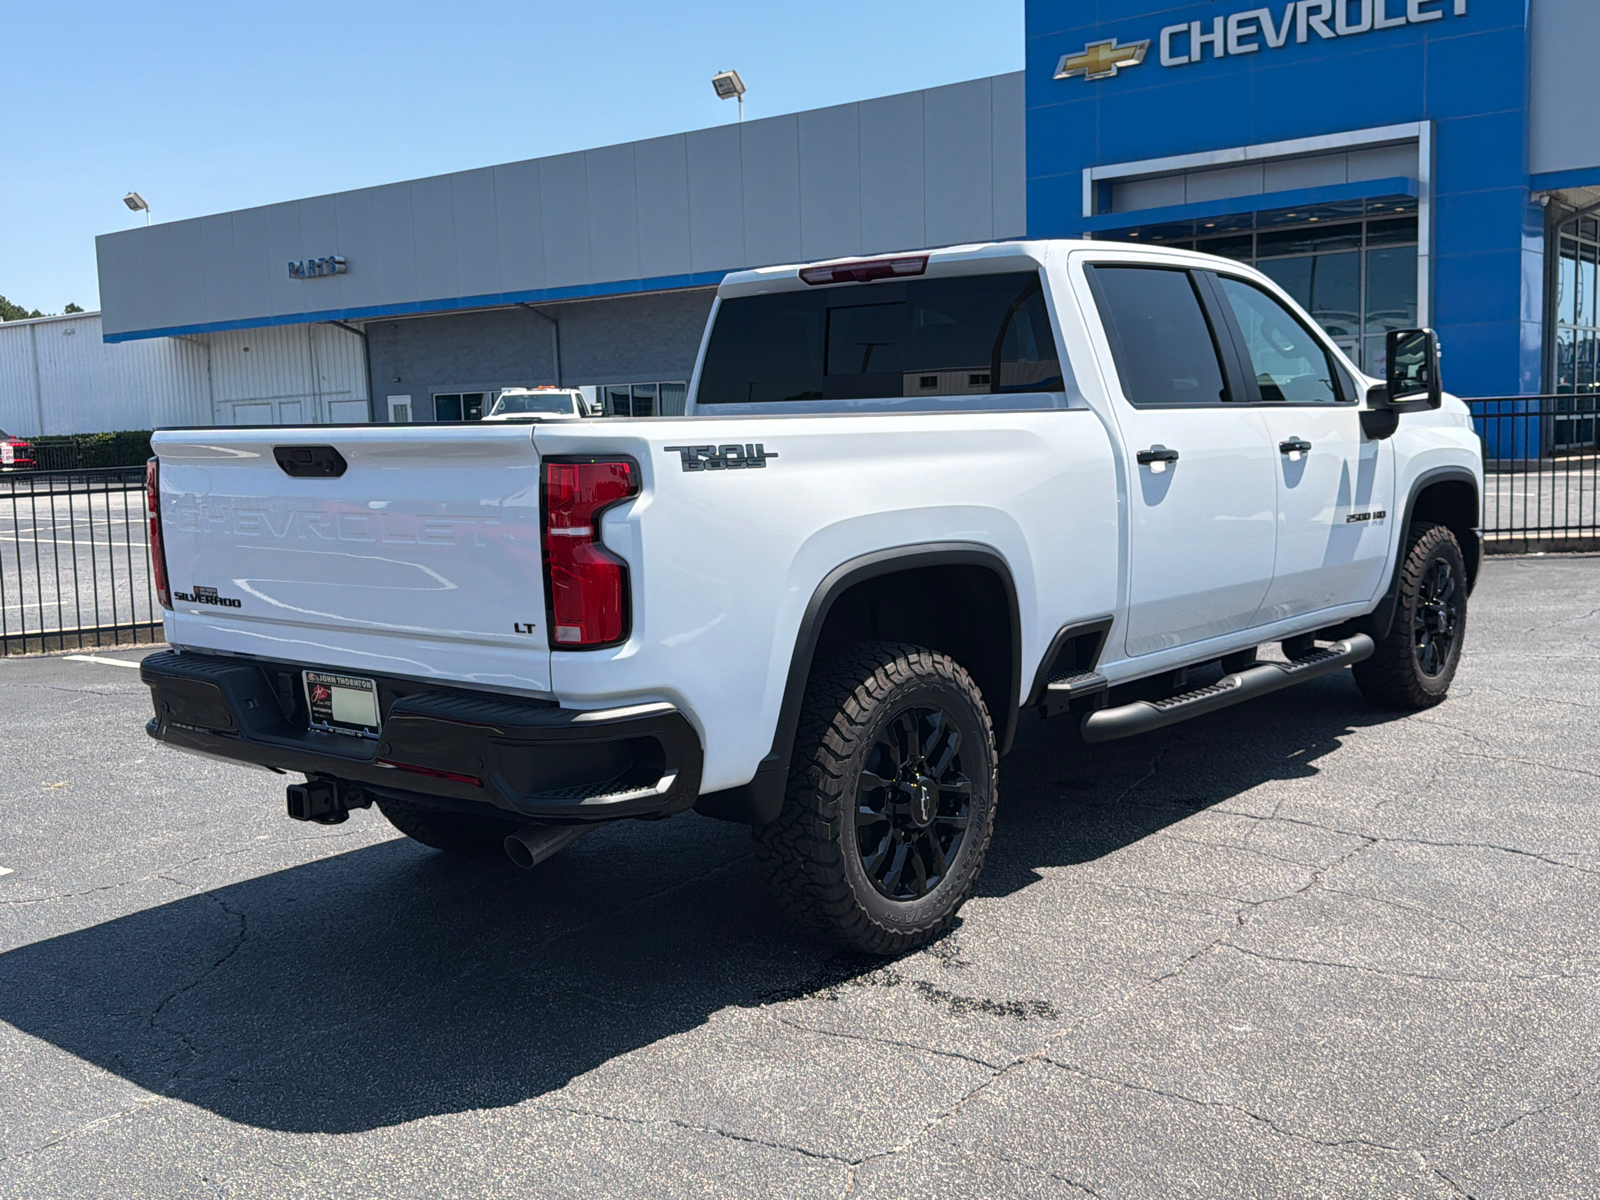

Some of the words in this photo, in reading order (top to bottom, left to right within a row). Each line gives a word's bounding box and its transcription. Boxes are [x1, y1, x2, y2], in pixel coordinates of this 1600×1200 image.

[288, 255, 345, 279] PARTS
[682, 458, 767, 472] BOSS
[1346, 512, 1371, 523] 2500
[1373, 510, 1386, 519] HD
[174, 591, 242, 608] SILVERADO
[514, 622, 536, 634] LT
[319, 674, 336, 684] JOHN
[336, 677, 372, 689] THORNTON
